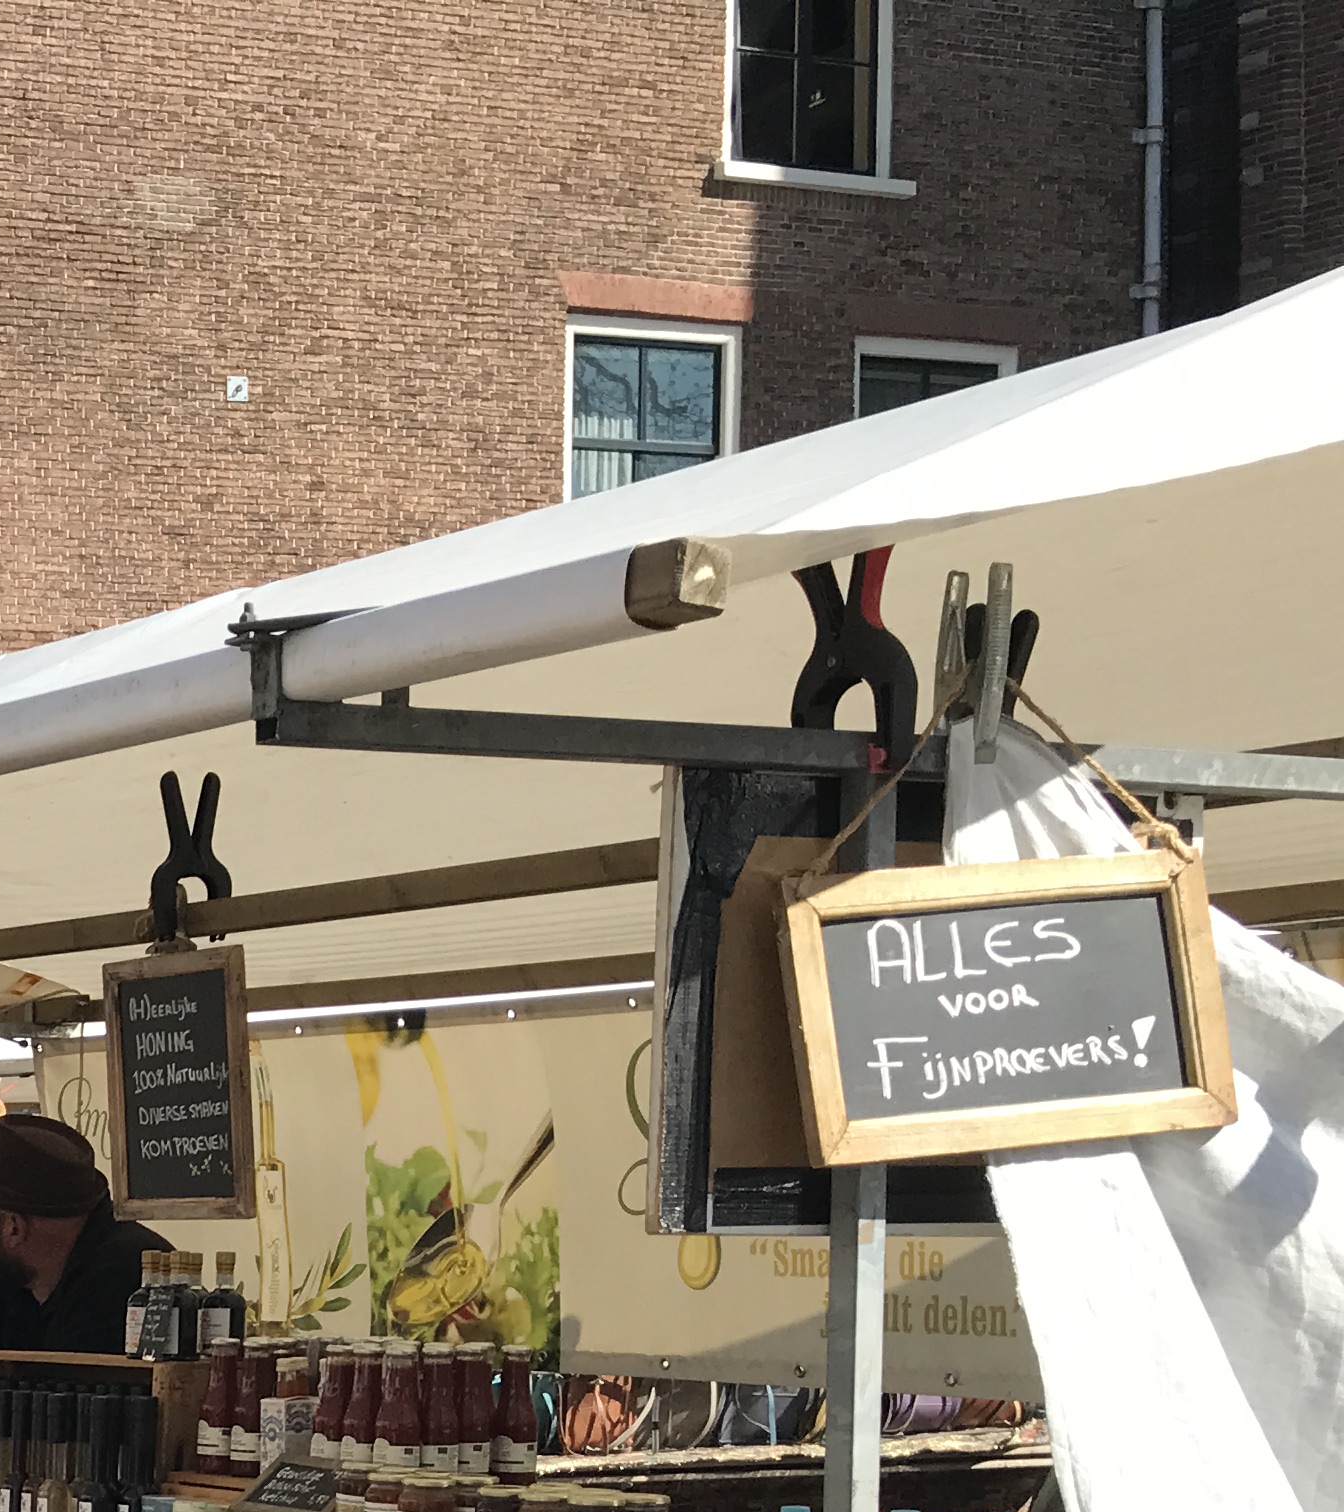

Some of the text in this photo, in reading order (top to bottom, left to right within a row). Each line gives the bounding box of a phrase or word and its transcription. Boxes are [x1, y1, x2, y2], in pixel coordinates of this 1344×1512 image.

[867, 917, 1081, 987] ALLES
[135, 1029, 194, 1060] HONING
[132, 1066, 164, 1095] 100%
[138, 1105, 188, 1126] DIVERSE
[140, 1133, 229, 1160] KOM PROEVEN
[898, 1241, 945, 1282] die
